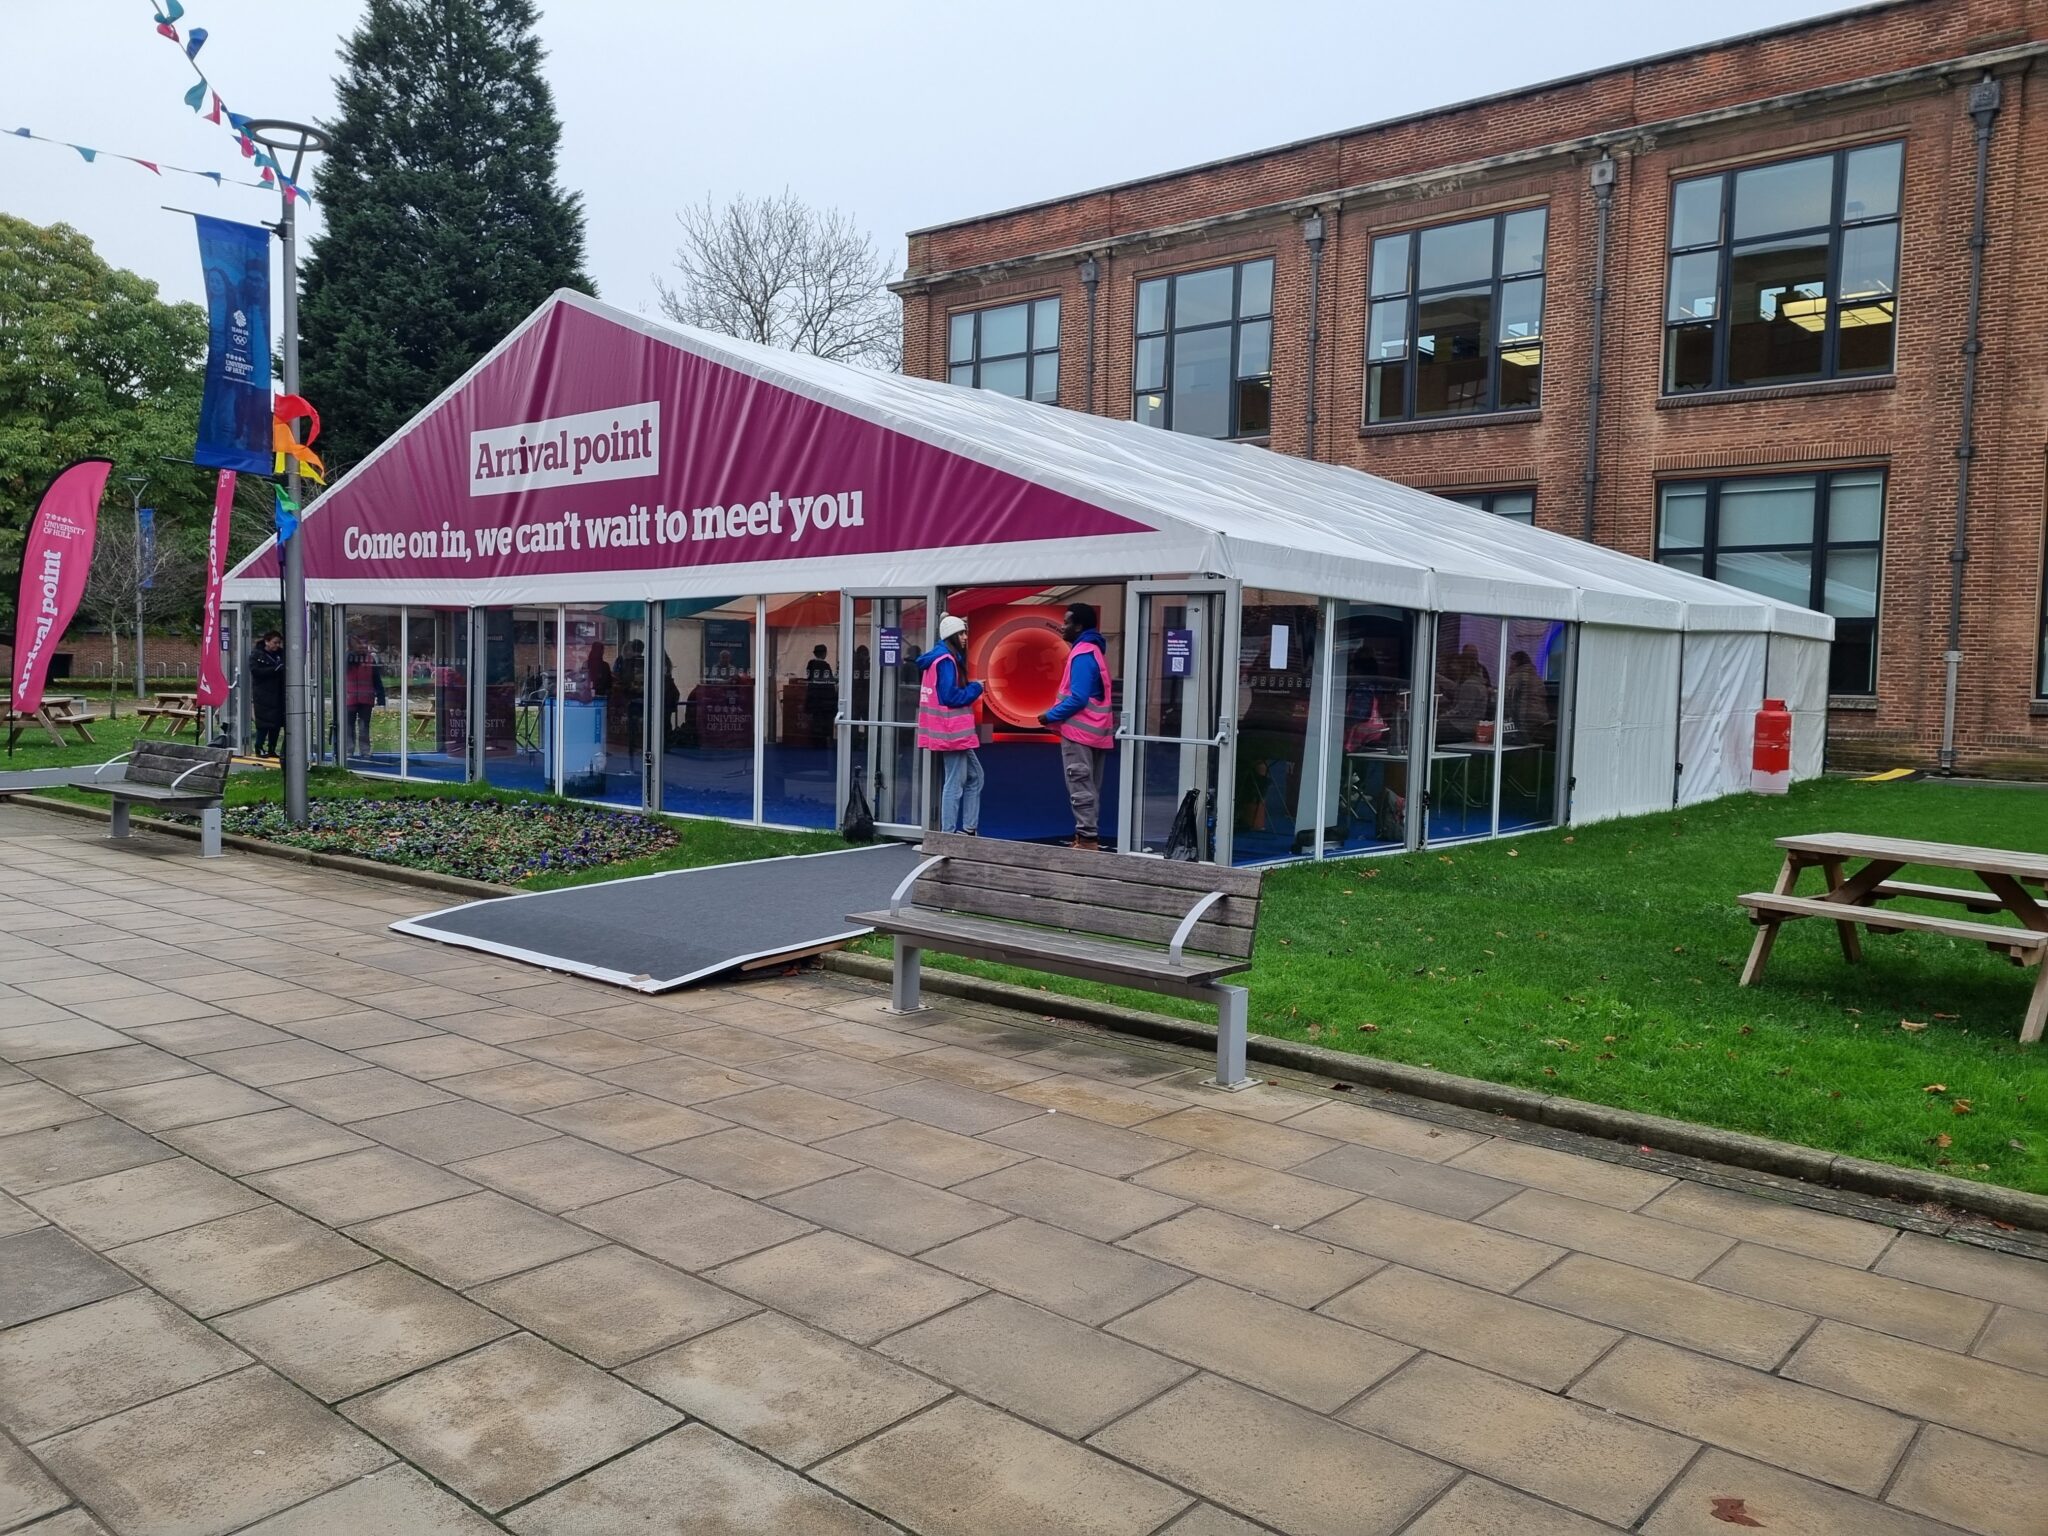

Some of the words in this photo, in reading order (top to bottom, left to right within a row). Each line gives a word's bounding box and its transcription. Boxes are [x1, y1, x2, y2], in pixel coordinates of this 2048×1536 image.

[475, 431, 569, 479] Arrival
[573, 419, 652, 475] point
[44, 519, 86, 536] UNIVERSITY
[52, 529, 72, 539] HULL
[344, 527, 405, 559] Come
[409, 529, 437, 558] on
[441, 521, 471, 562] in,
[475, 527, 512, 557] we
[585, 504, 650, 549] wait
[654, 505, 687, 544] to
[692, 492, 782, 542] meet
[788, 490, 864, 542] you
[18, 616, 53, 699] Arrival
[39, 549, 62, 616] point
